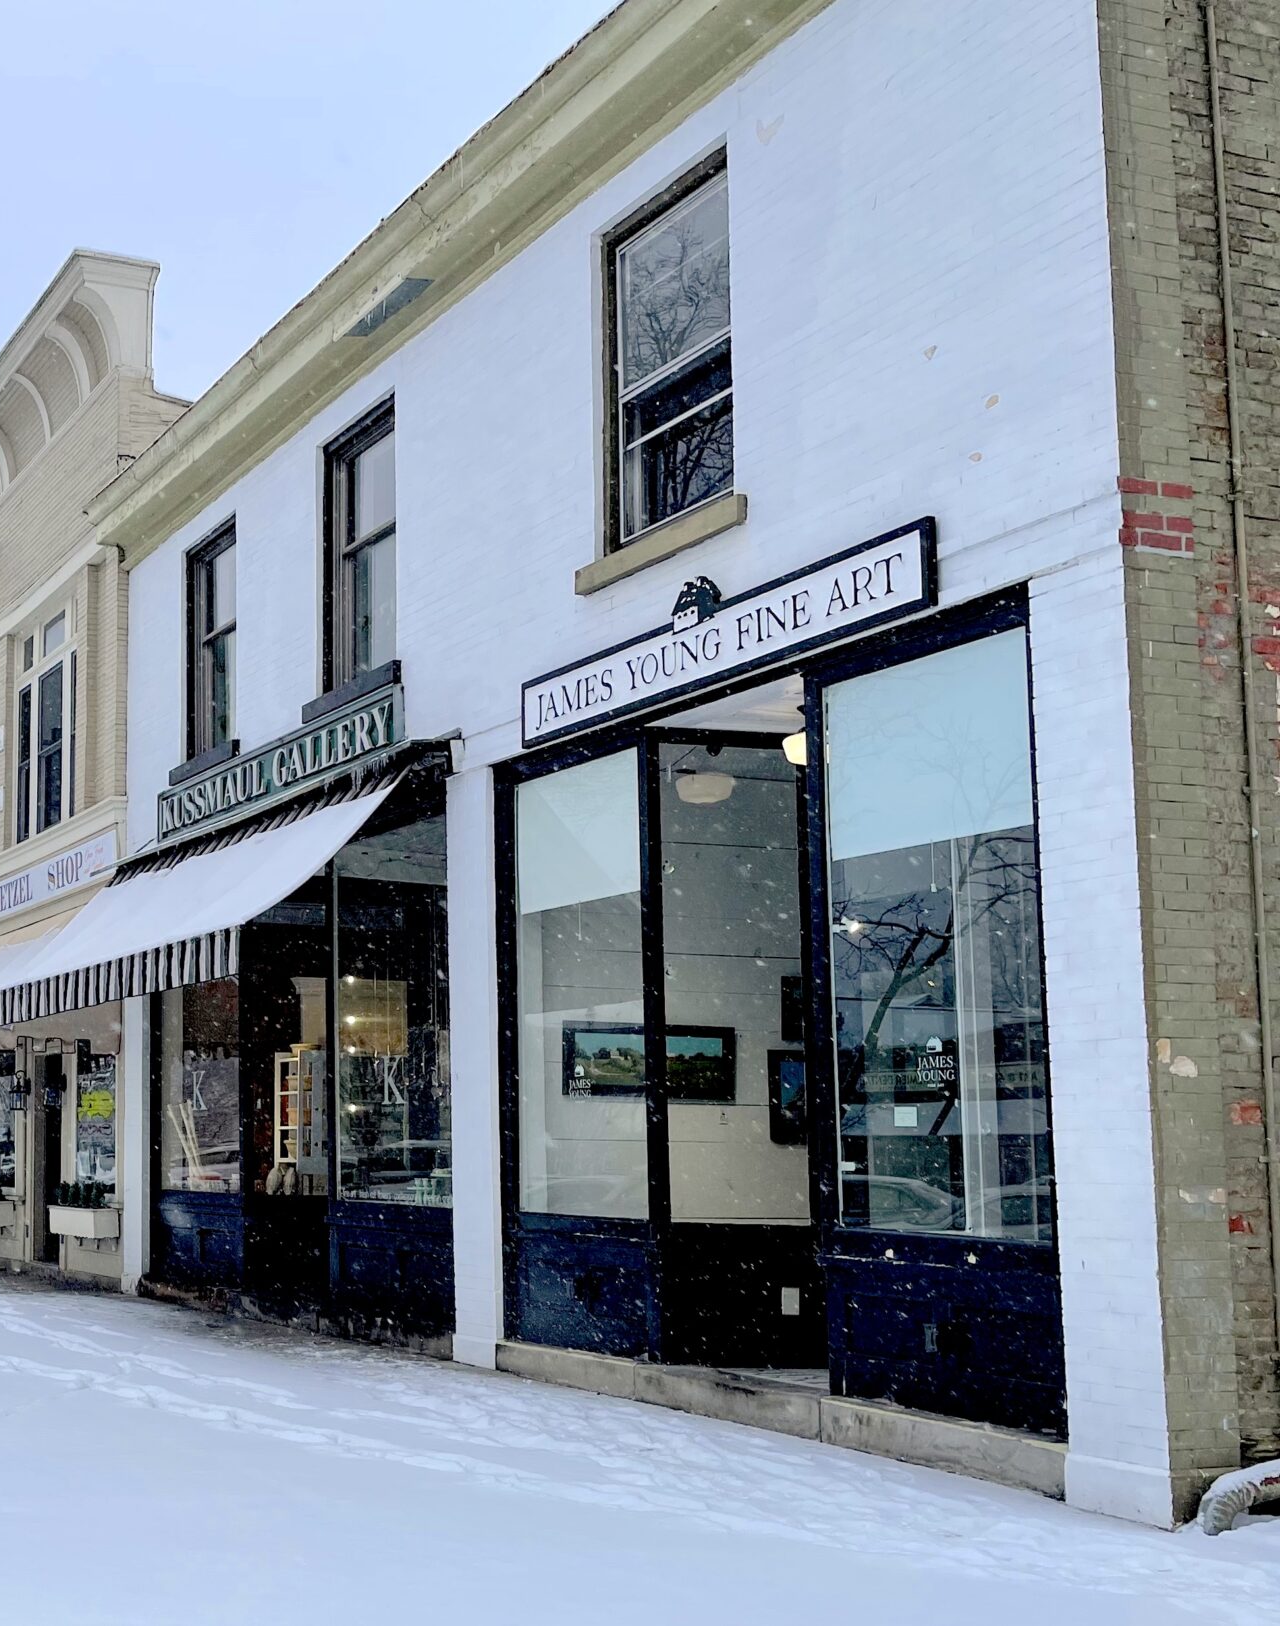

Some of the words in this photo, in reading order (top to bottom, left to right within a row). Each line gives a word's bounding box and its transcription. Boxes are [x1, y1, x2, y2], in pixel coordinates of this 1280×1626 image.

[535, 669, 613, 730] JAMES
[625, 628, 721, 691] YOUNG
[735, 590, 811, 650] FINE
[825, 553, 902, 618] ART
[160, 761, 267, 833] KUSSMAUL
[272, 702, 392, 787] GALLERY
[47, 851, 83, 891] SHOP
[917, 1069, 955, 1082] YOUNG
[918, 1055, 954, 1071] JAMES
[569, 1079, 591, 1090] JAMES
